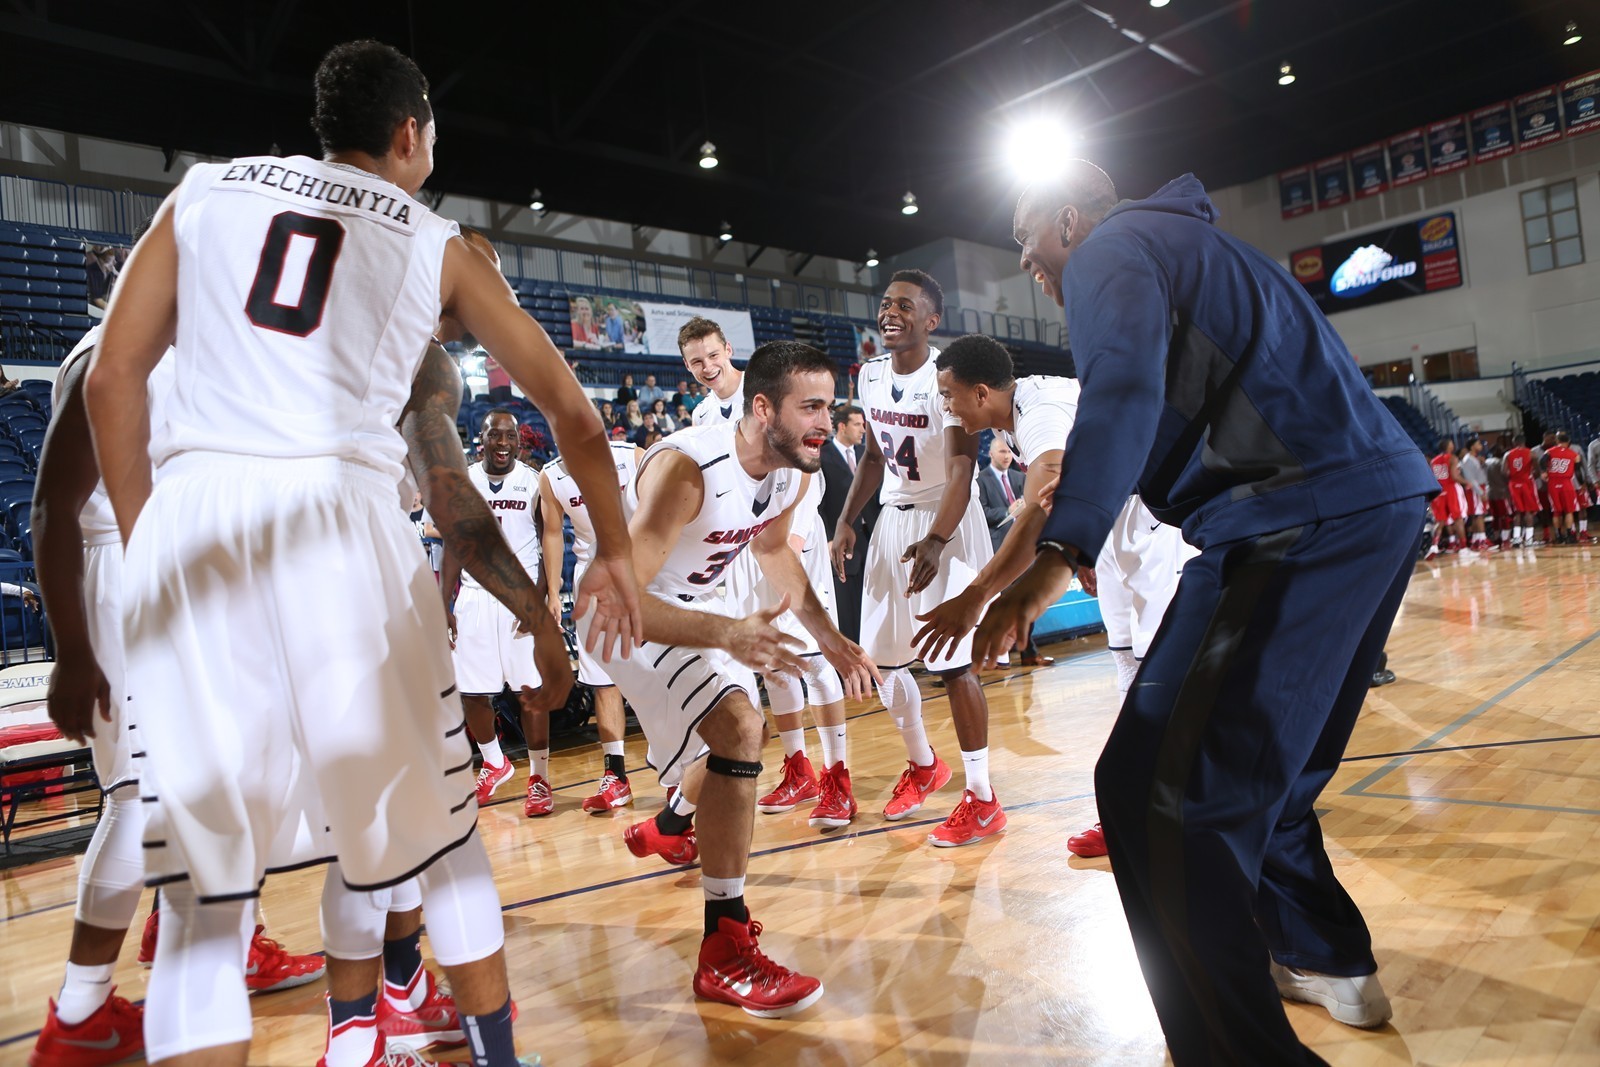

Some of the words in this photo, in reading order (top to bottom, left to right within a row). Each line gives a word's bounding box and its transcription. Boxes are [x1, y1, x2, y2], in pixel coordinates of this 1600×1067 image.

[222, 163, 411, 226] ENECHIONYIA
[244, 210, 346, 338] 0
[1335, 260, 1417, 293] SAMFORD
[871, 407, 929, 429] SAMFORD
[881, 430, 921, 482] 24
